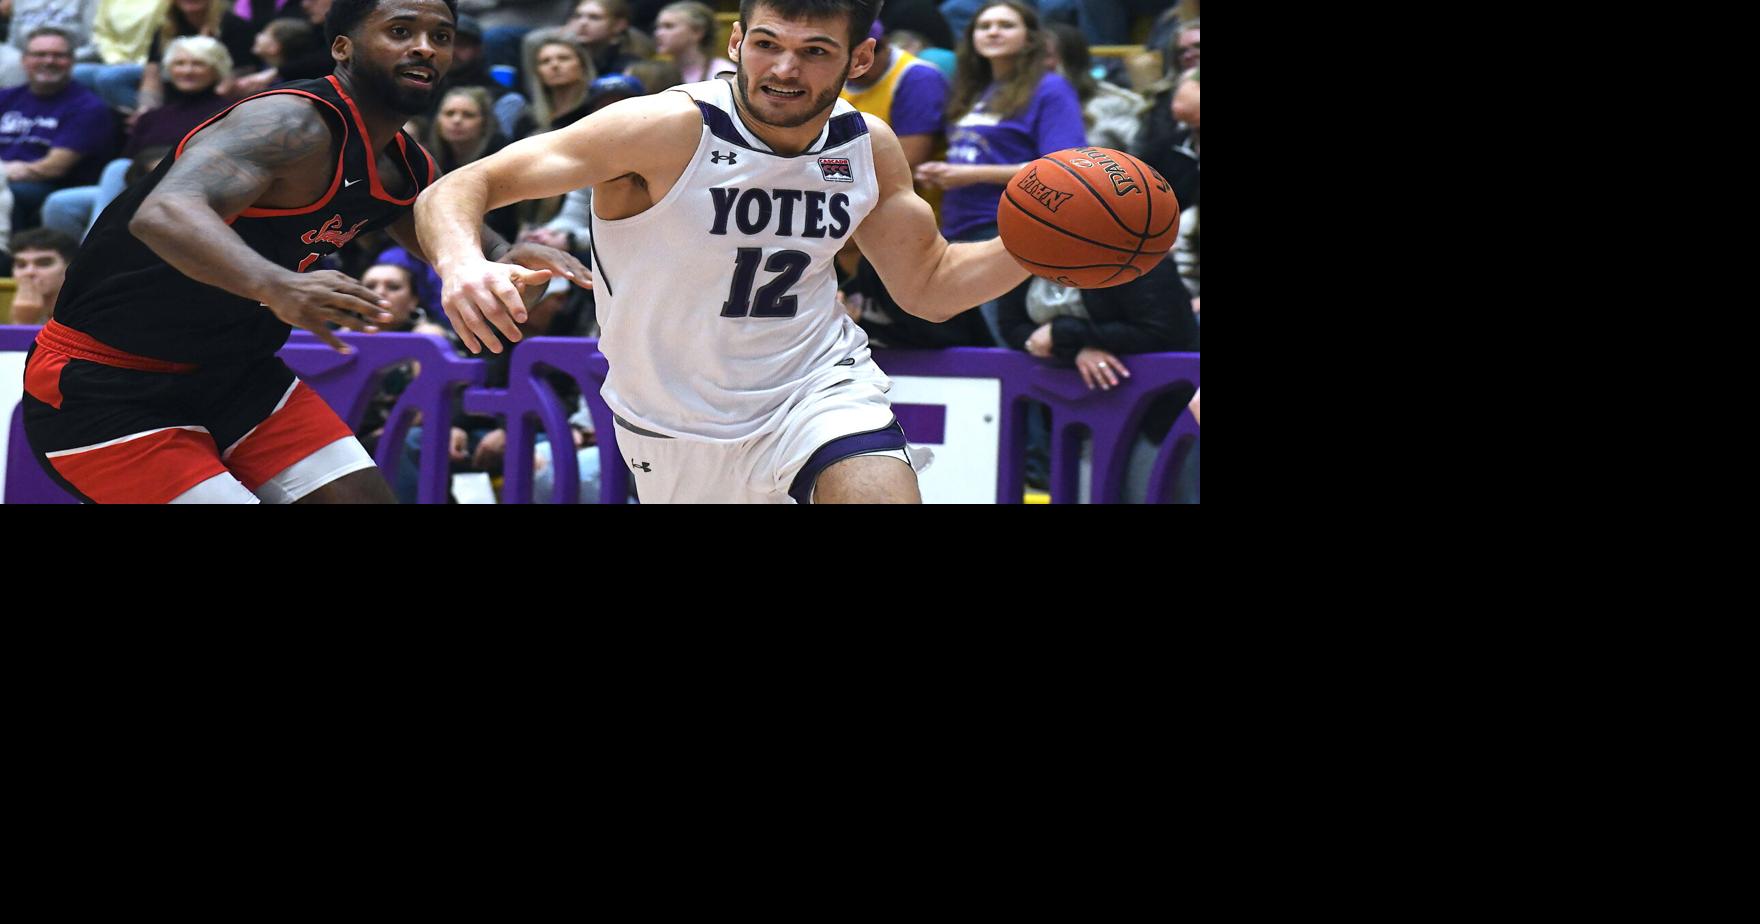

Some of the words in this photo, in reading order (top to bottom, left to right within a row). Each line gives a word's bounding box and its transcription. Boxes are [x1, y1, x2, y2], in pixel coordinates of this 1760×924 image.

[708, 188, 851, 239] YOTES
[1016, 166, 1074, 213] NAIA
[719, 247, 812, 318] 12
